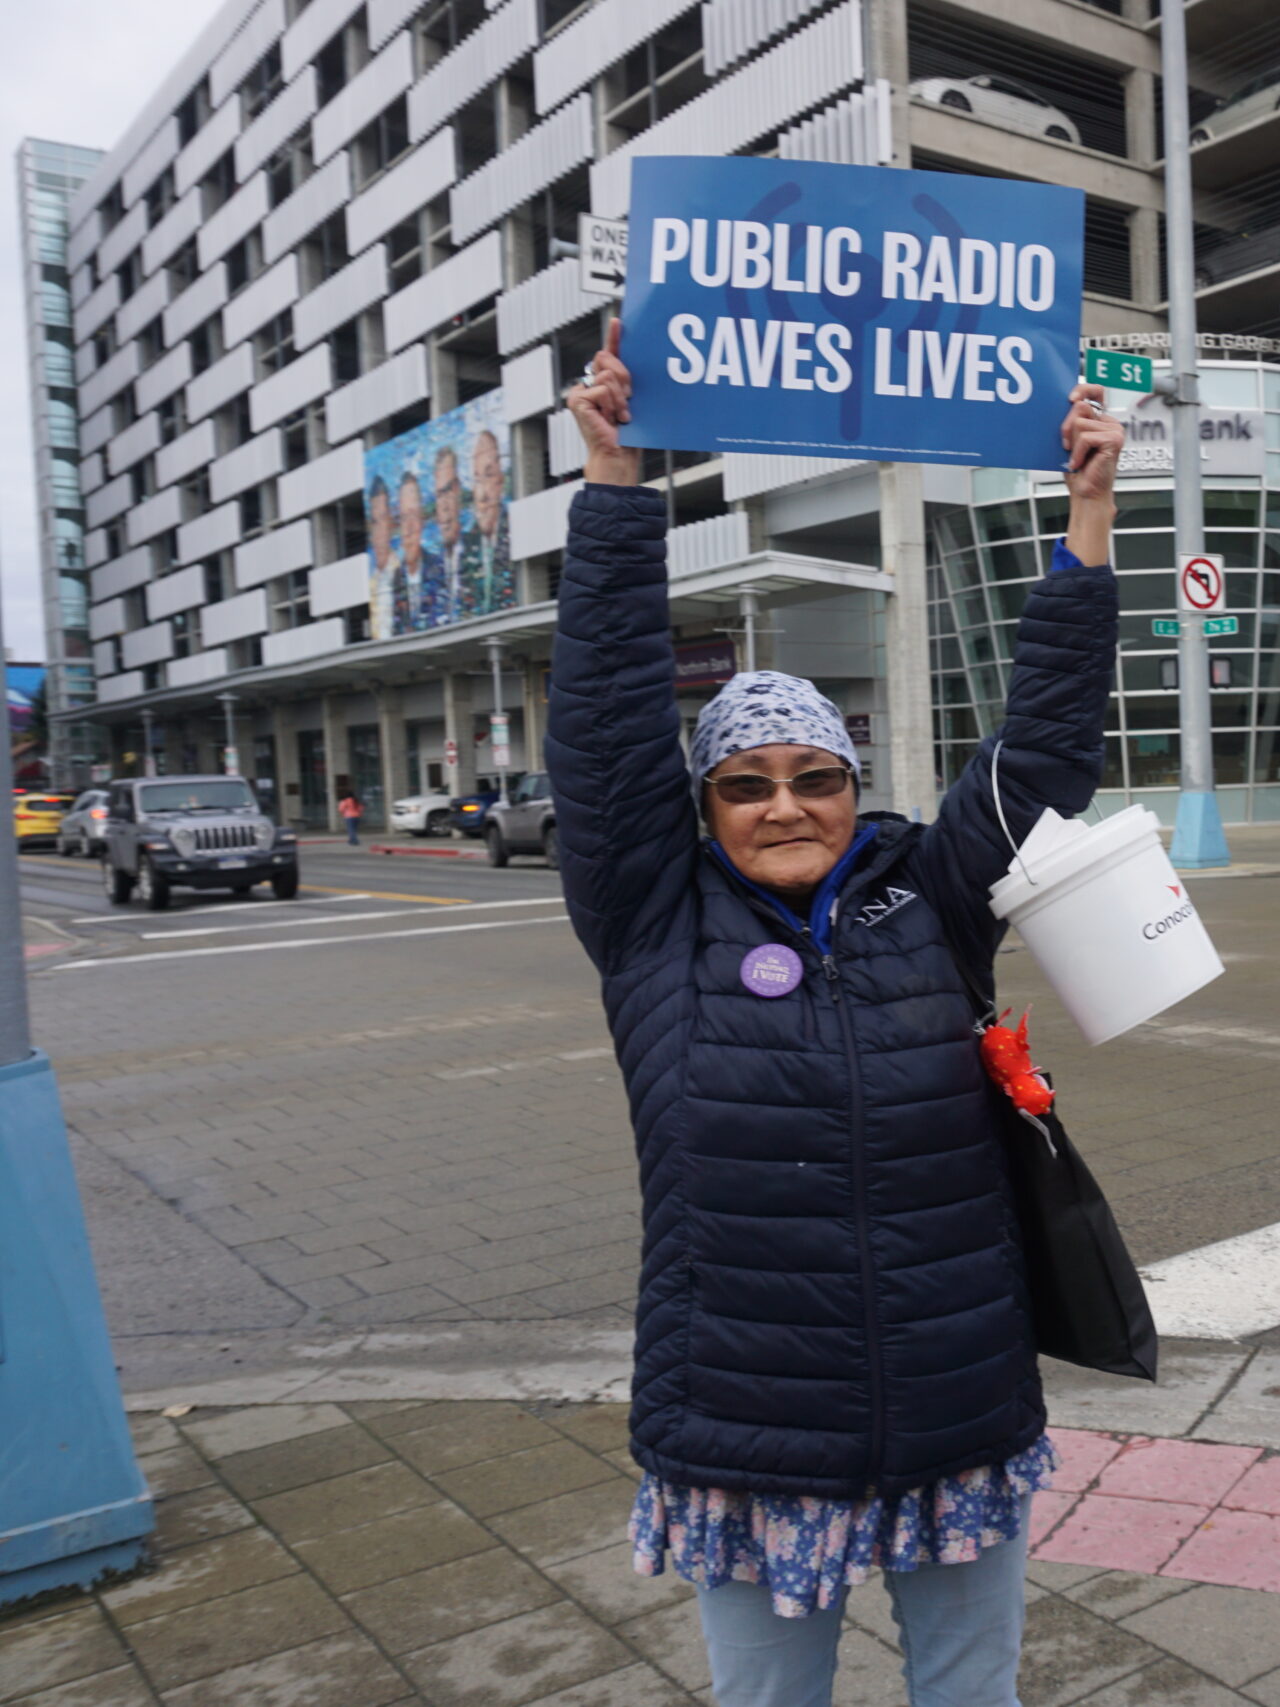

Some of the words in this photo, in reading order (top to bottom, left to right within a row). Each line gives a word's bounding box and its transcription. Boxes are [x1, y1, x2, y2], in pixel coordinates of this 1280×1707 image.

[649, 217, 862, 297] PUBLIC
[882, 231, 1055, 312] RADIO
[667, 313, 852, 393] SAVES
[874, 327, 1033, 404] LIVES
[1096, 359, 1108, 378] E
[1121, 363, 1142, 384] St
